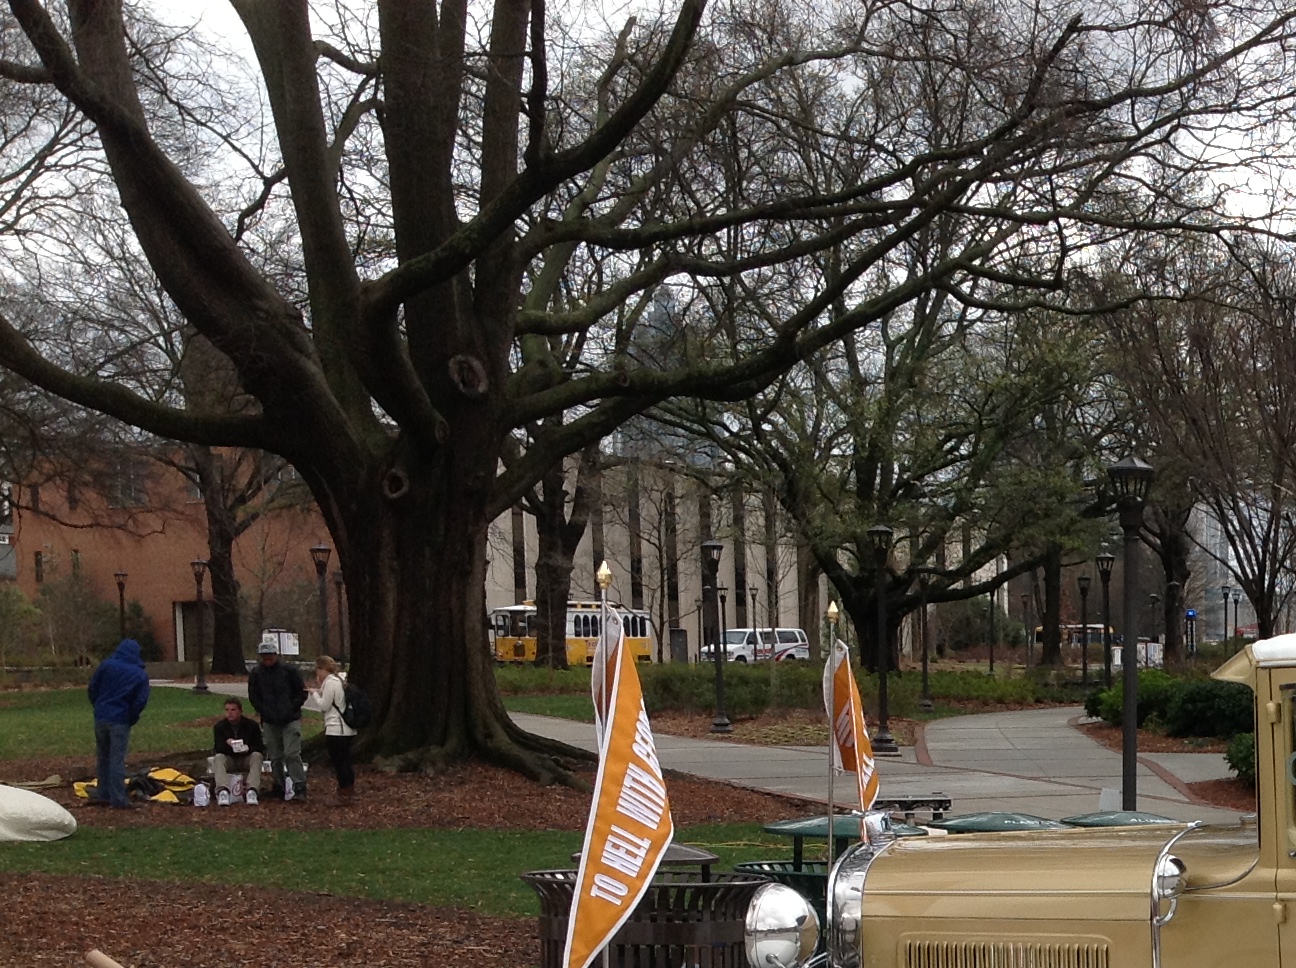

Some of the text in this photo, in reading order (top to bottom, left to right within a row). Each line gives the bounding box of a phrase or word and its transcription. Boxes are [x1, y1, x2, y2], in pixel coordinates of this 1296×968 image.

[616, 761, 667, 830] WITH
[600, 824, 652, 878] HELL
[590, 873, 629, 906] TO
